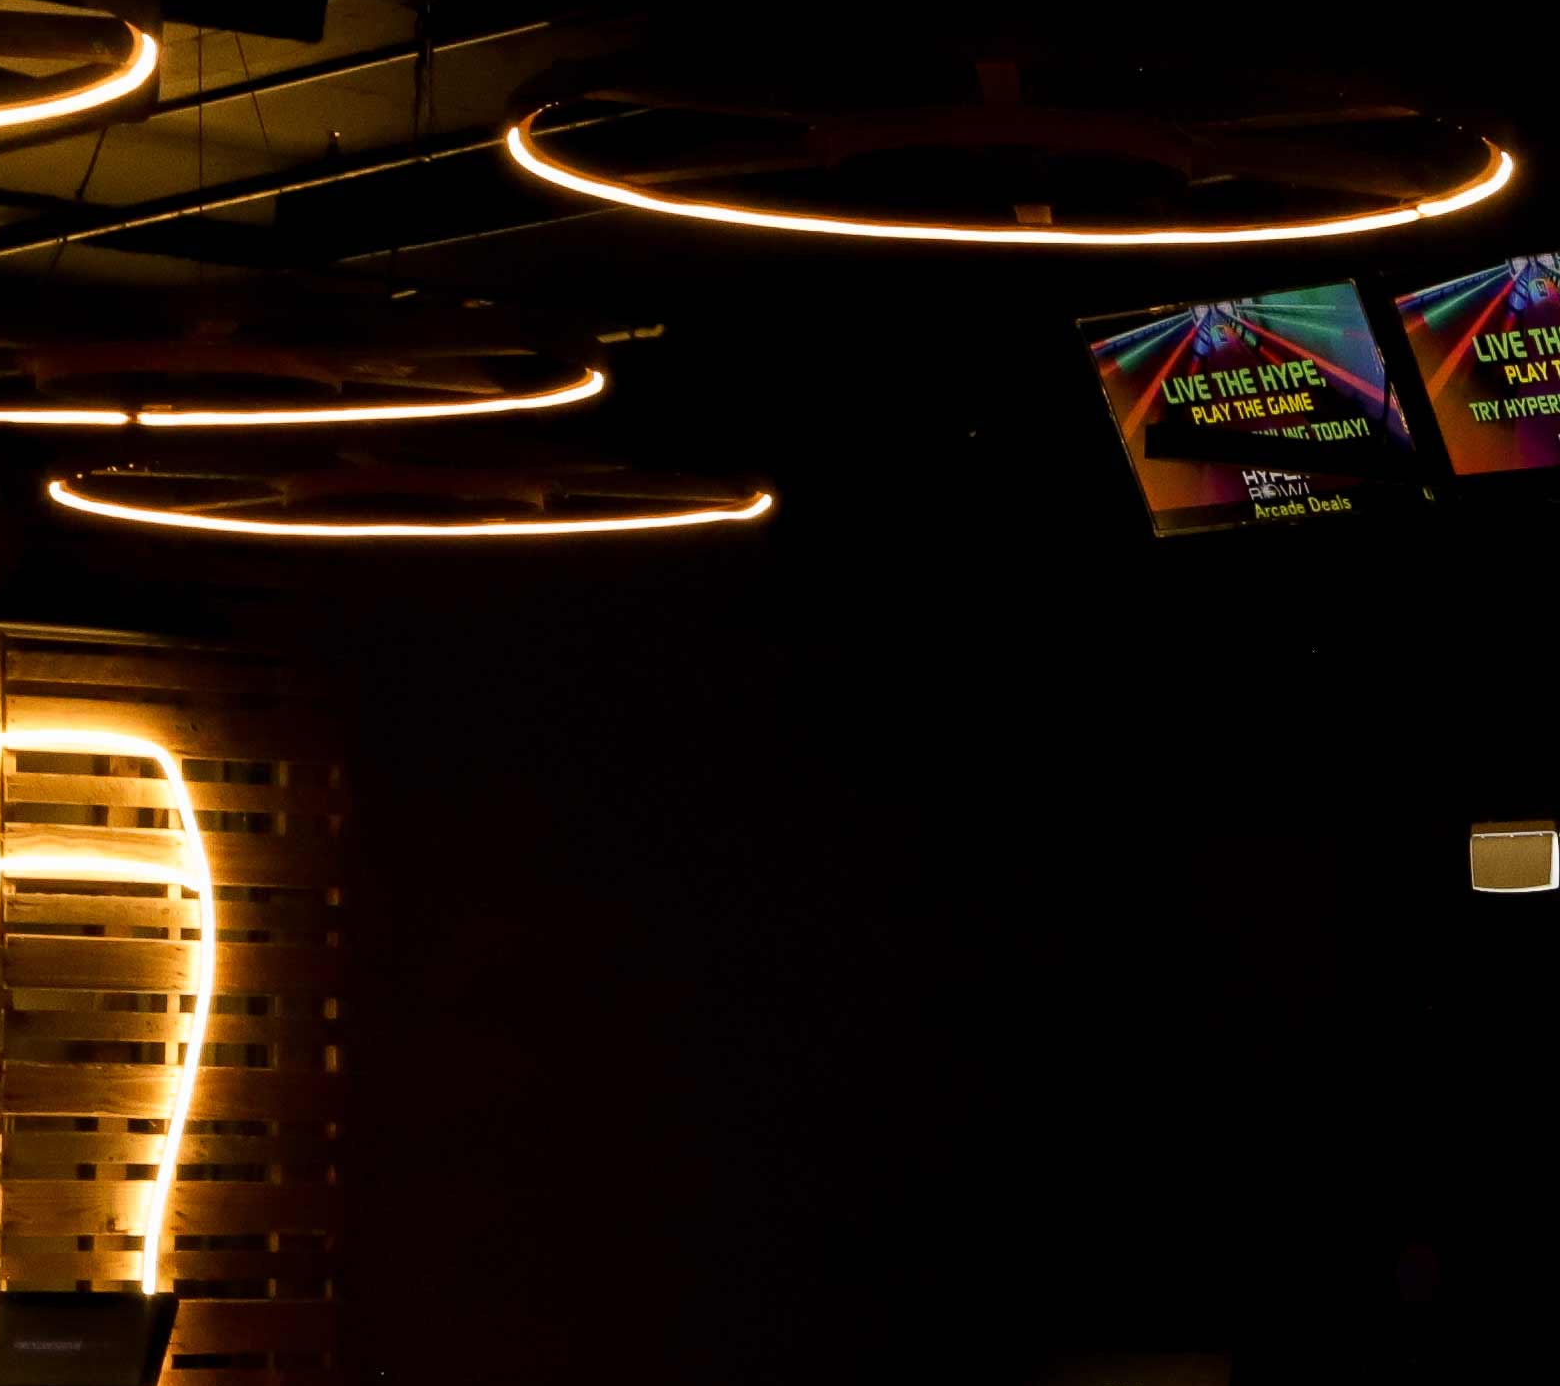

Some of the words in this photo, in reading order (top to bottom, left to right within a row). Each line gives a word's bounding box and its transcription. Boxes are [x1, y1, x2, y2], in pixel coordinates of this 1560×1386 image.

[1472, 331, 1528, 362] LIVE
[1160, 374, 1212, 405] LIVE
[1211, 368, 1257, 397] THE
[1257, 360, 1326, 392] HYPE,
[1504, 361, 1548, 385] PLAY
[1191, 403, 1231, 425] PLAY
[1233, 398, 1265, 419] THE
[1267, 392, 1314, 414] GAME
[1469, 400, 1501, 421] TRY
[1311, 418, 1370, 442] TODAY!
[1254, 500, 1306, 519] Arcade
[1307, 495, 1352, 513] Deals
